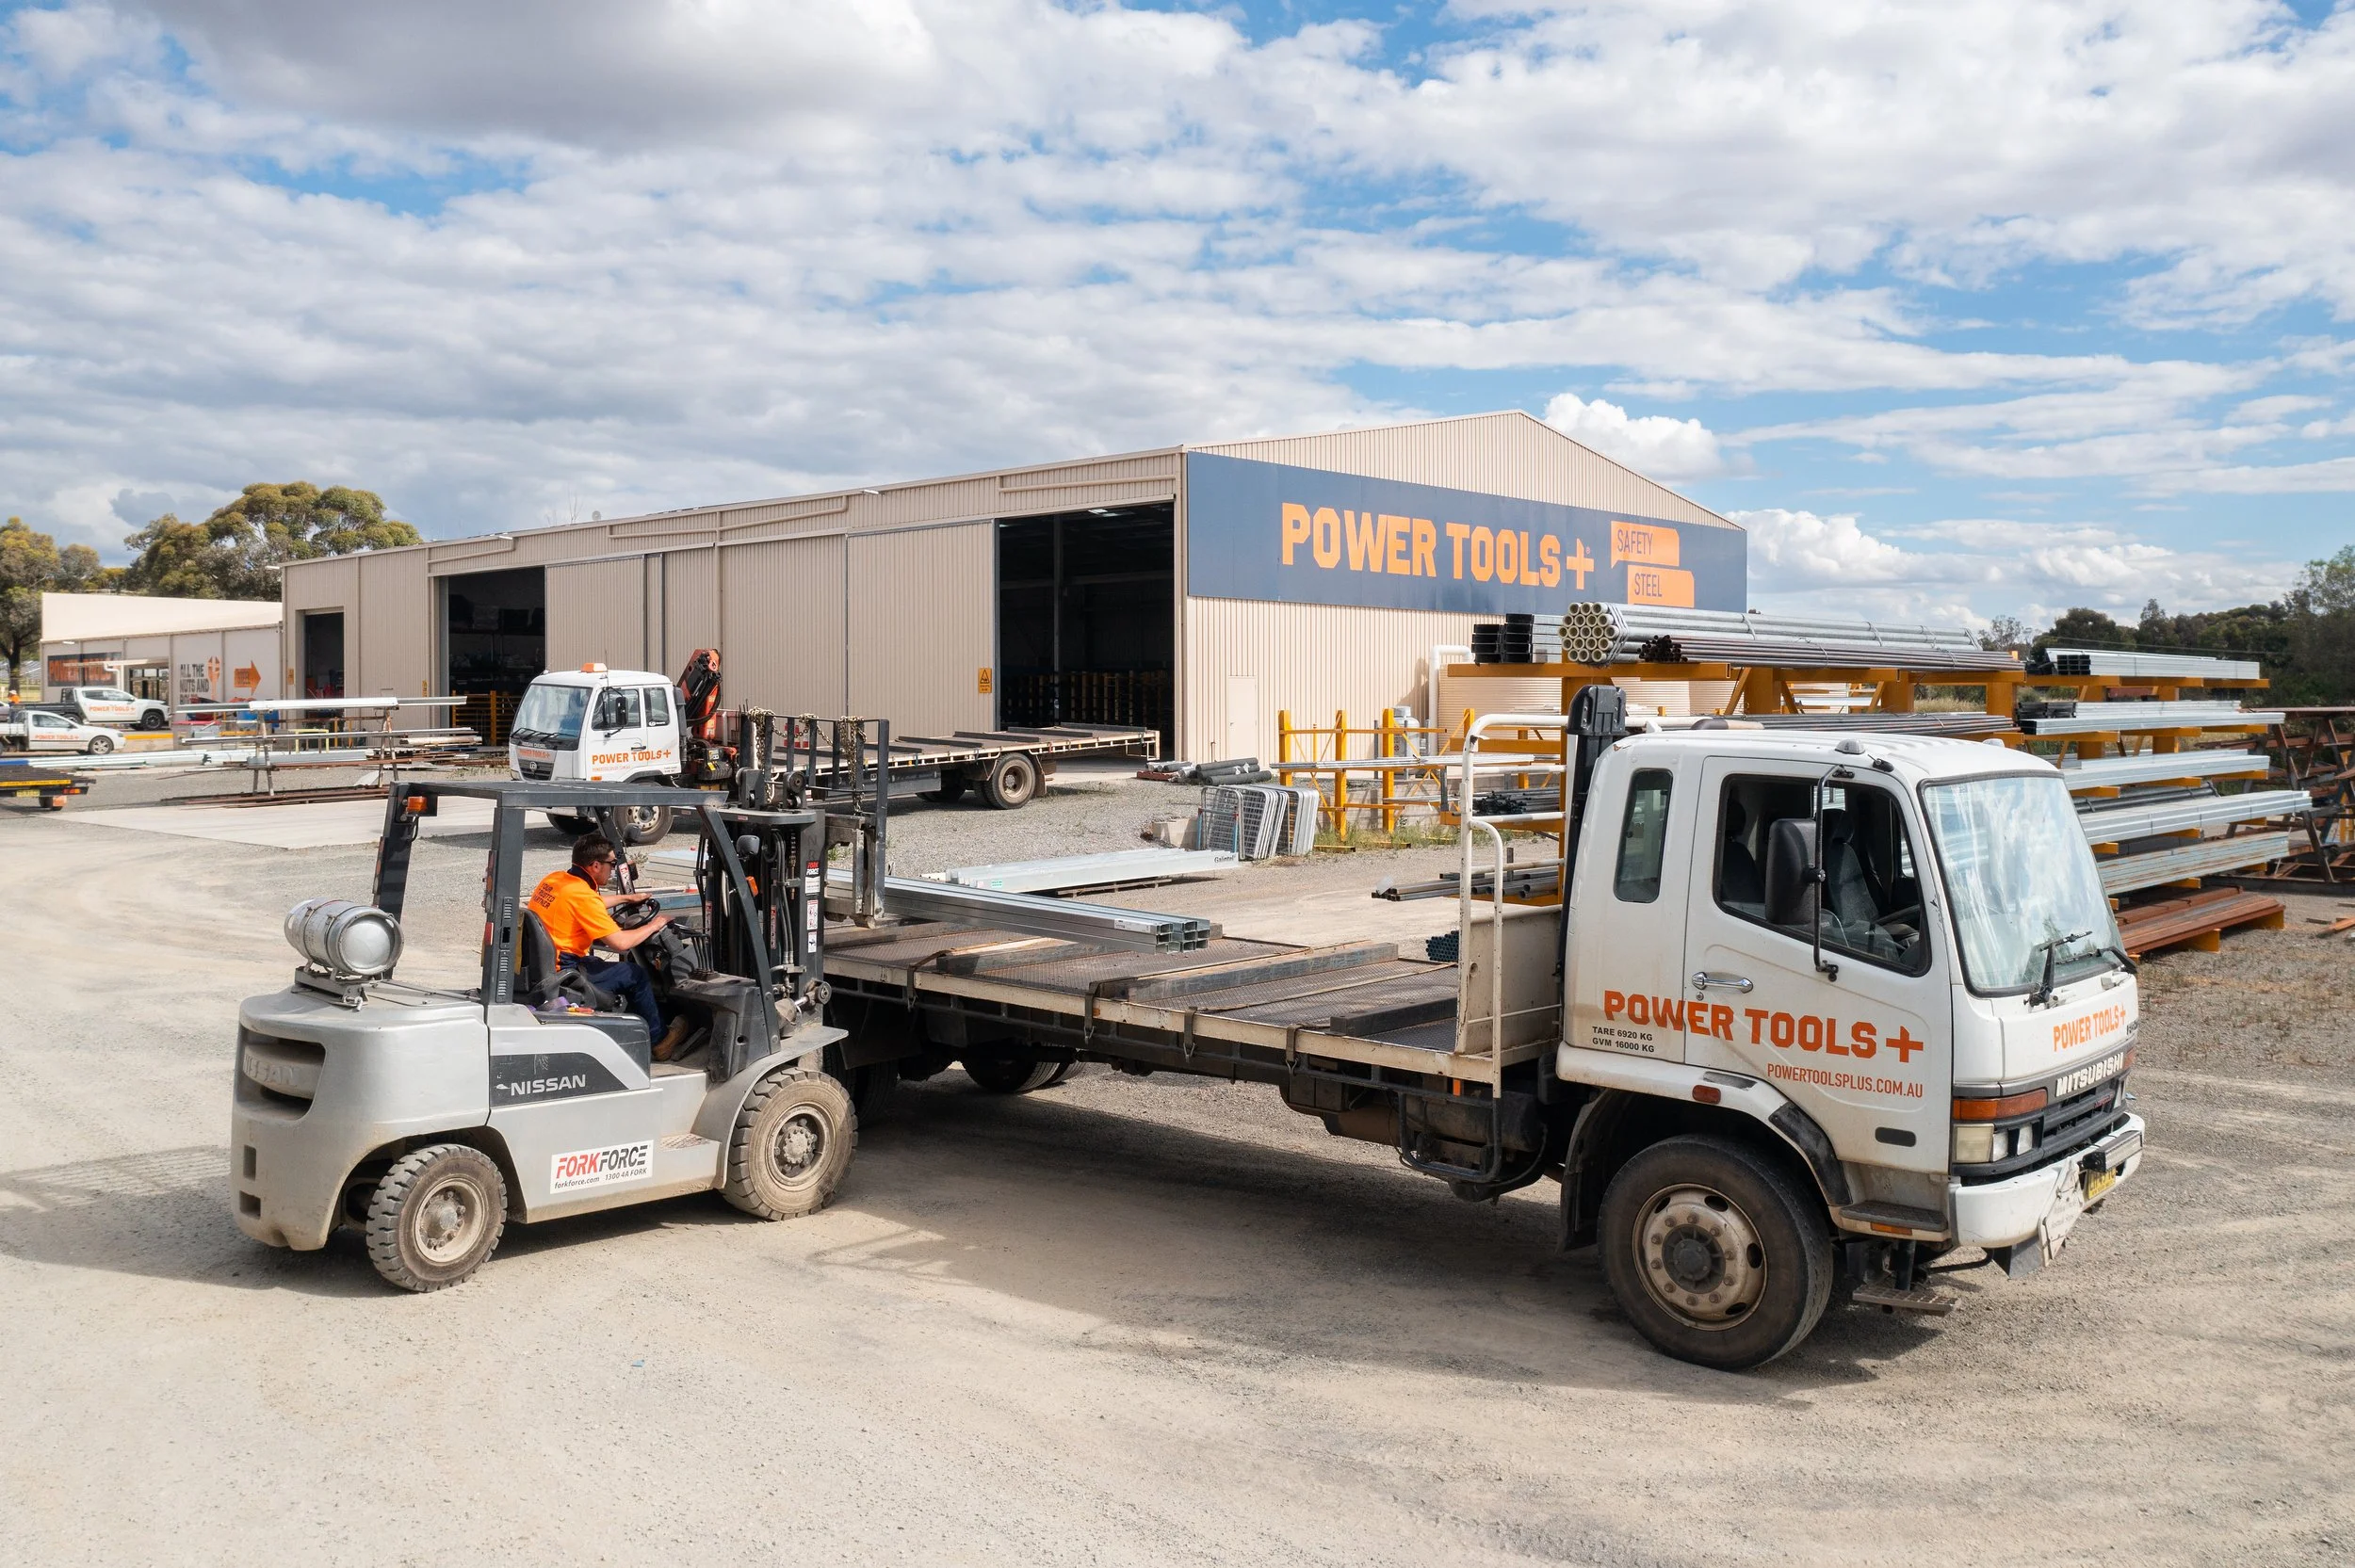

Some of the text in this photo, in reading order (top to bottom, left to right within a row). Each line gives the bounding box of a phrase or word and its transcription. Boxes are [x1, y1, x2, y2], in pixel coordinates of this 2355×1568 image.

[1282, 502, 1437, 577] POWER
[1616, 529, 1654, 556] SAFETY
[1633, 573, 1663, 598] STEEL
[180, 664, 205, 677] ALL THE
[180, 678, 210, 692] NUTS AND
[592, 752, 629, 765] POWER
[1604, 990, 1734, 1042] POWER
[1592, 1026, 1653, 1041] TARE 6920 KG
[1592, 1037, 1654, 1053] GVM 16000 KG
[2054, 1016, 2091, 1052] POWER
[511, 1074, 586, 1096] NISSAN
[1766, 1063, 1924, 1099] POWERTOOLSPLUS.COM.AU
[2055, 1052, 2123, 1097] MITSUBISHI
[554, 1176, 600, 1189] forkforce.com
[605, 1172, 620, 1181] 1300
[629, 1168, 647, 1176] FORK
